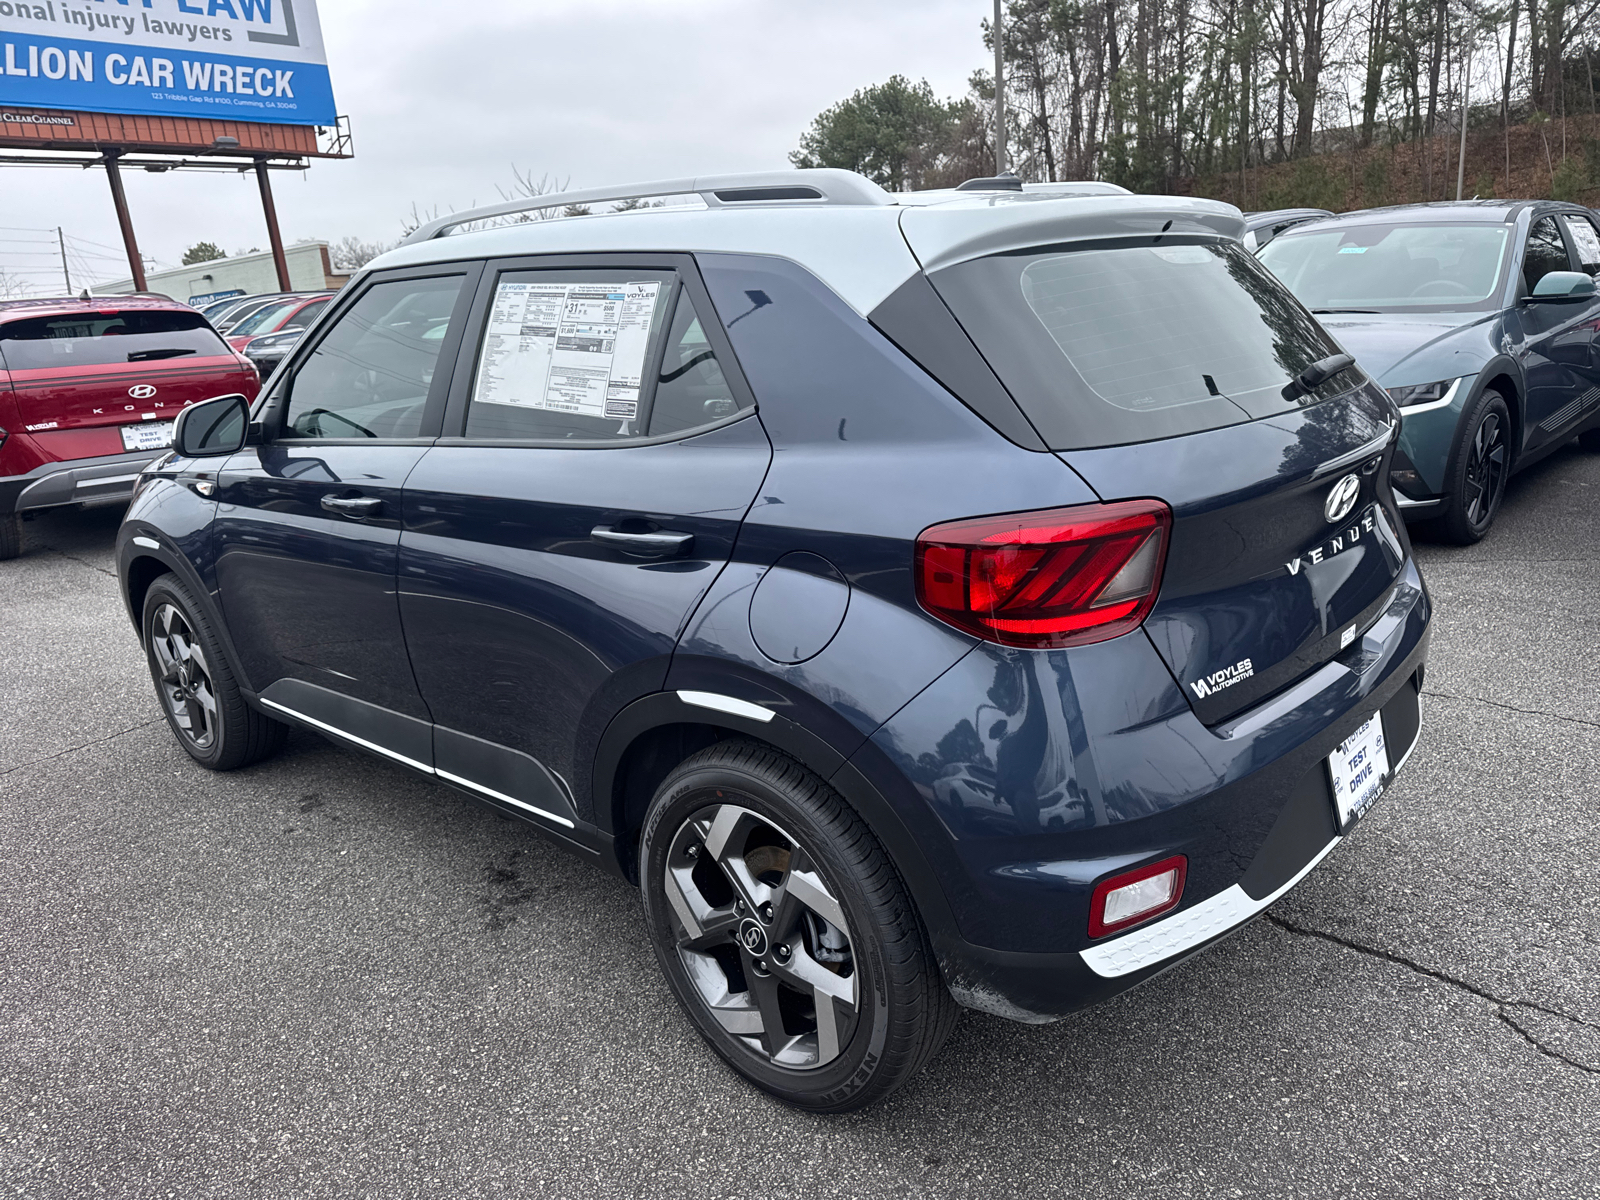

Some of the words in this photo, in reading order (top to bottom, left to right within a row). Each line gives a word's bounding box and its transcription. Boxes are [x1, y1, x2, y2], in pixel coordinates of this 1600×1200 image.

[0, 0, 56, 22] onal
[61, 2, 135, 35] injury
[142, 12, 233, 42] lawyers
[0, 43, 93, 82] LION
[105, 53, 175, 89] CAR
[182, 60, 295, 98] WRECK
[151, 92, 163, 100] 123
[165, 93, 188, 102] Tribble
[189, 95, 203, 104] Gap
[234, 99, 264, 108] Cumming,
[277, 102, 298, 110] 30040
[569, 302, 579, 313] 31
[93, 399, 194, 415] KONA
[1285, 516, 1374, 576] VENUE
[1207, 658, 1253, 686] VOYLES
[1212, 668, 1255, 694] AUTOMOTIVE
[1348, 721, 1370, 746] VOYLES
[1348, 745, 1367, 772] TEST
[1349, 761, 1373, 794] DRIVE
[1365, 784, 1384, 809] VOYLES
[818, 1050, 880, 1105] NEXEN
